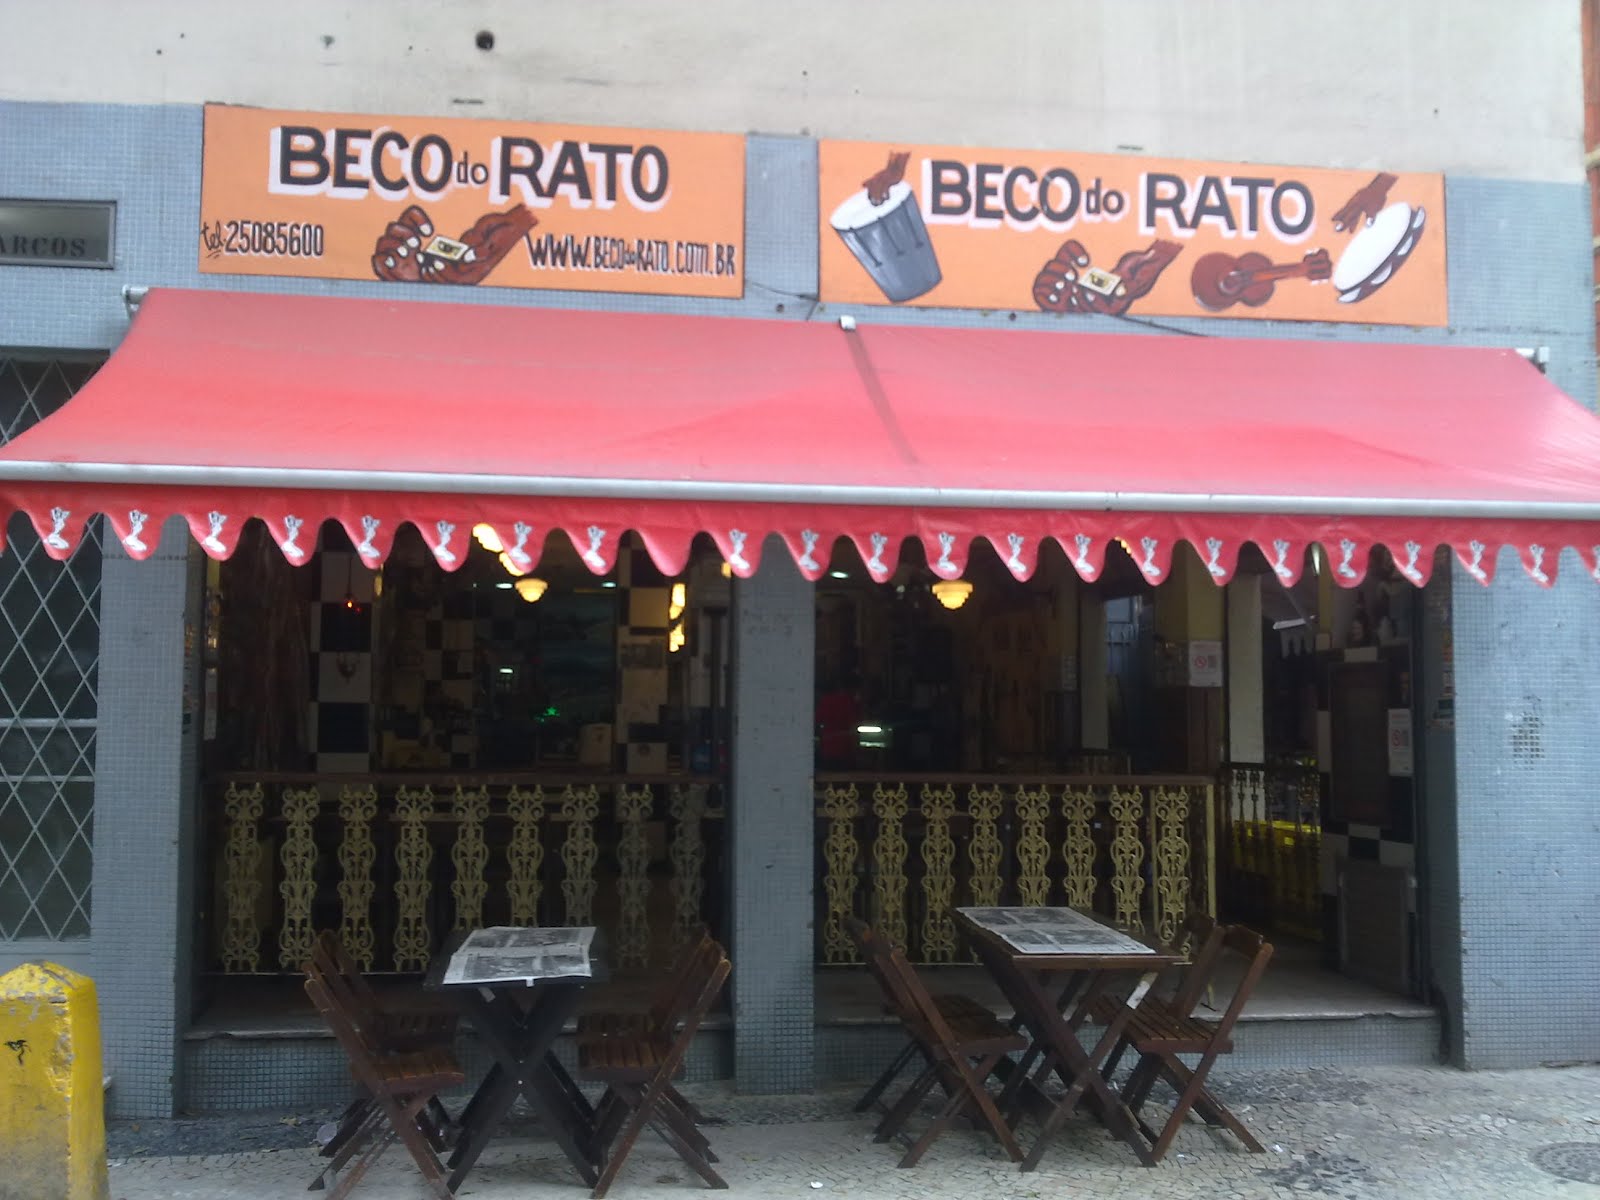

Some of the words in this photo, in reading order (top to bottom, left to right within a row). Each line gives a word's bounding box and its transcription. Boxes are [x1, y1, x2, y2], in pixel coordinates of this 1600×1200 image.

[280, 124, 452, 193] BECO
[456, 150, 489, 185] do
[499, 135, 670, 202] RATO
[929, 159, 1081, 223] BECO
[1085, 178, 1124, 215] do
[1146, 173, 1315, 236] RATO
[224, 220, 324, 256] 25085600
